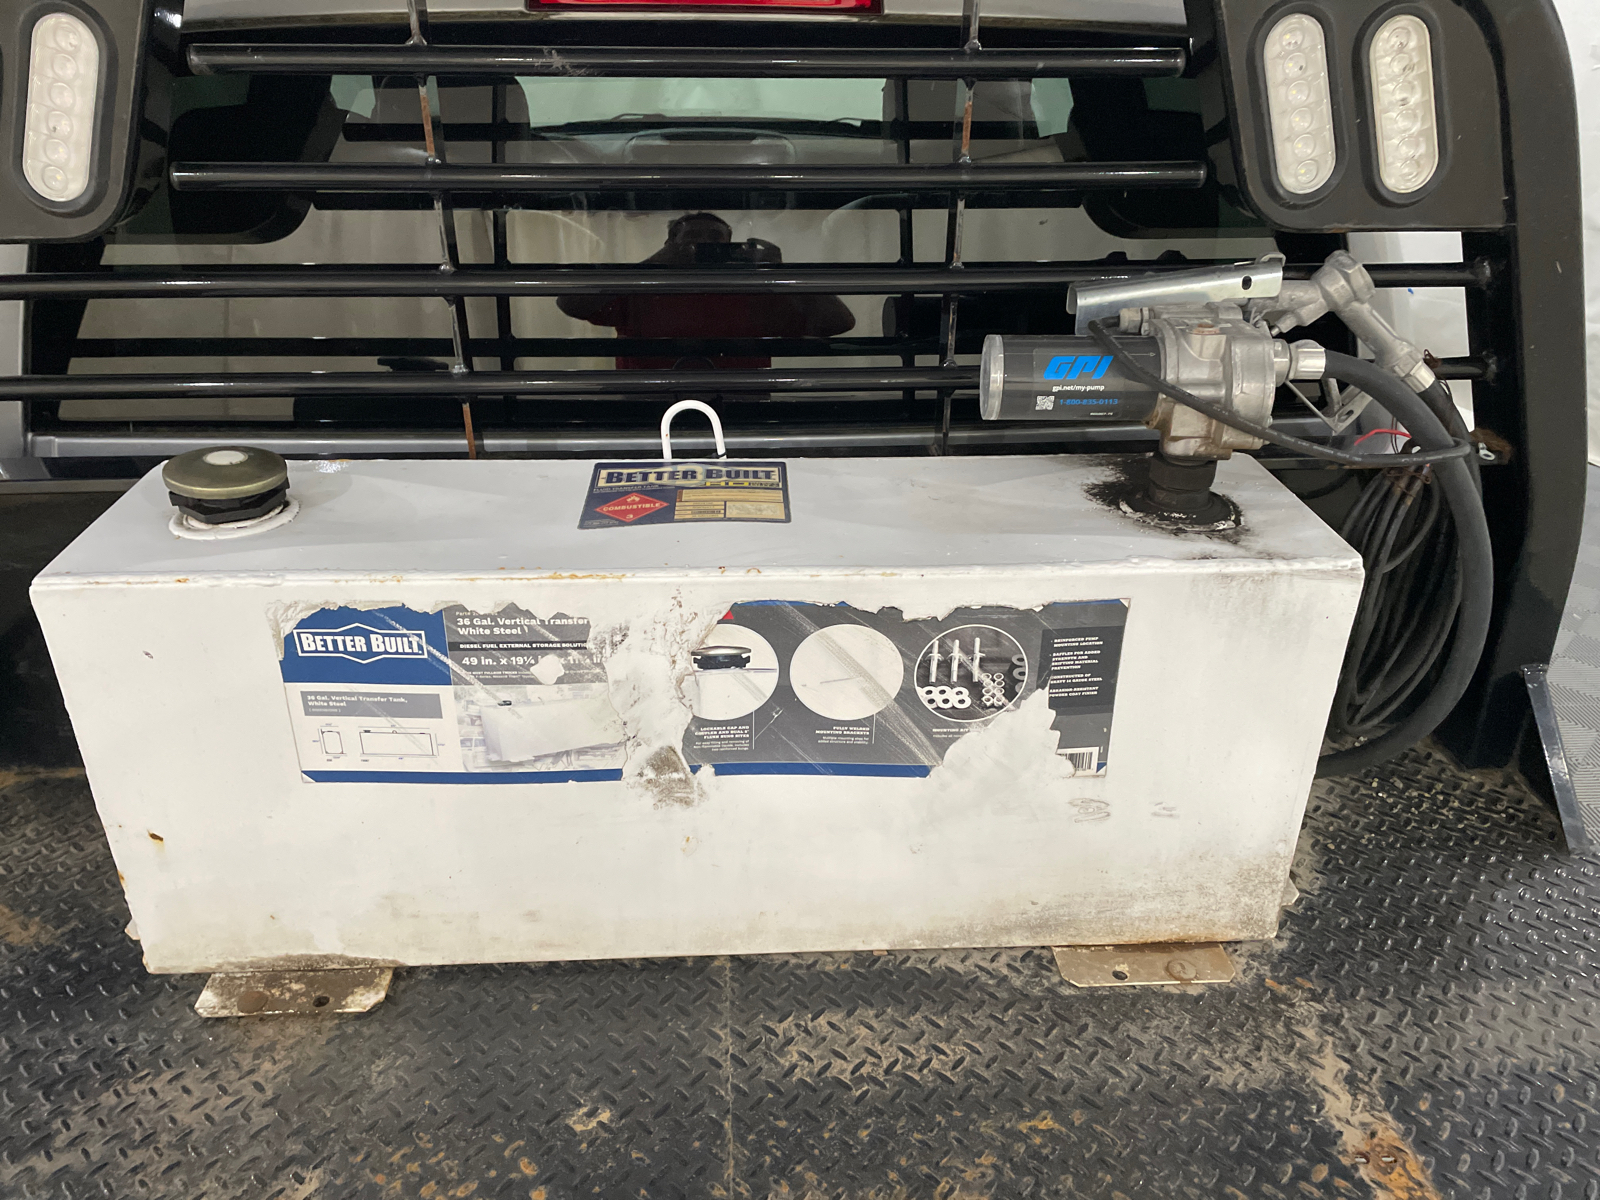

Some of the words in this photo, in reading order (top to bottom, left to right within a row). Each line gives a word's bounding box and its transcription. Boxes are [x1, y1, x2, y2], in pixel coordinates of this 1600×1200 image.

[1043, 355, 1114, 380] GPI
[605, 470, 698, 484] BETTER
[705, 468, 776, 480] BUILT
[602, 503, 661, 511] COMBUSTIBLE
[456, 617, 471, 625] 36
[473, 617, 495, 625] Gal.
[497, 617, 541, 625] Vertical
[458, 627, 491, 635] White
[493, 627, 522, 635] Steel
[300, 633, 367, 652] BETTER
[461, 656, 478, 665] 49
[481, 656, 497, 665] in.
